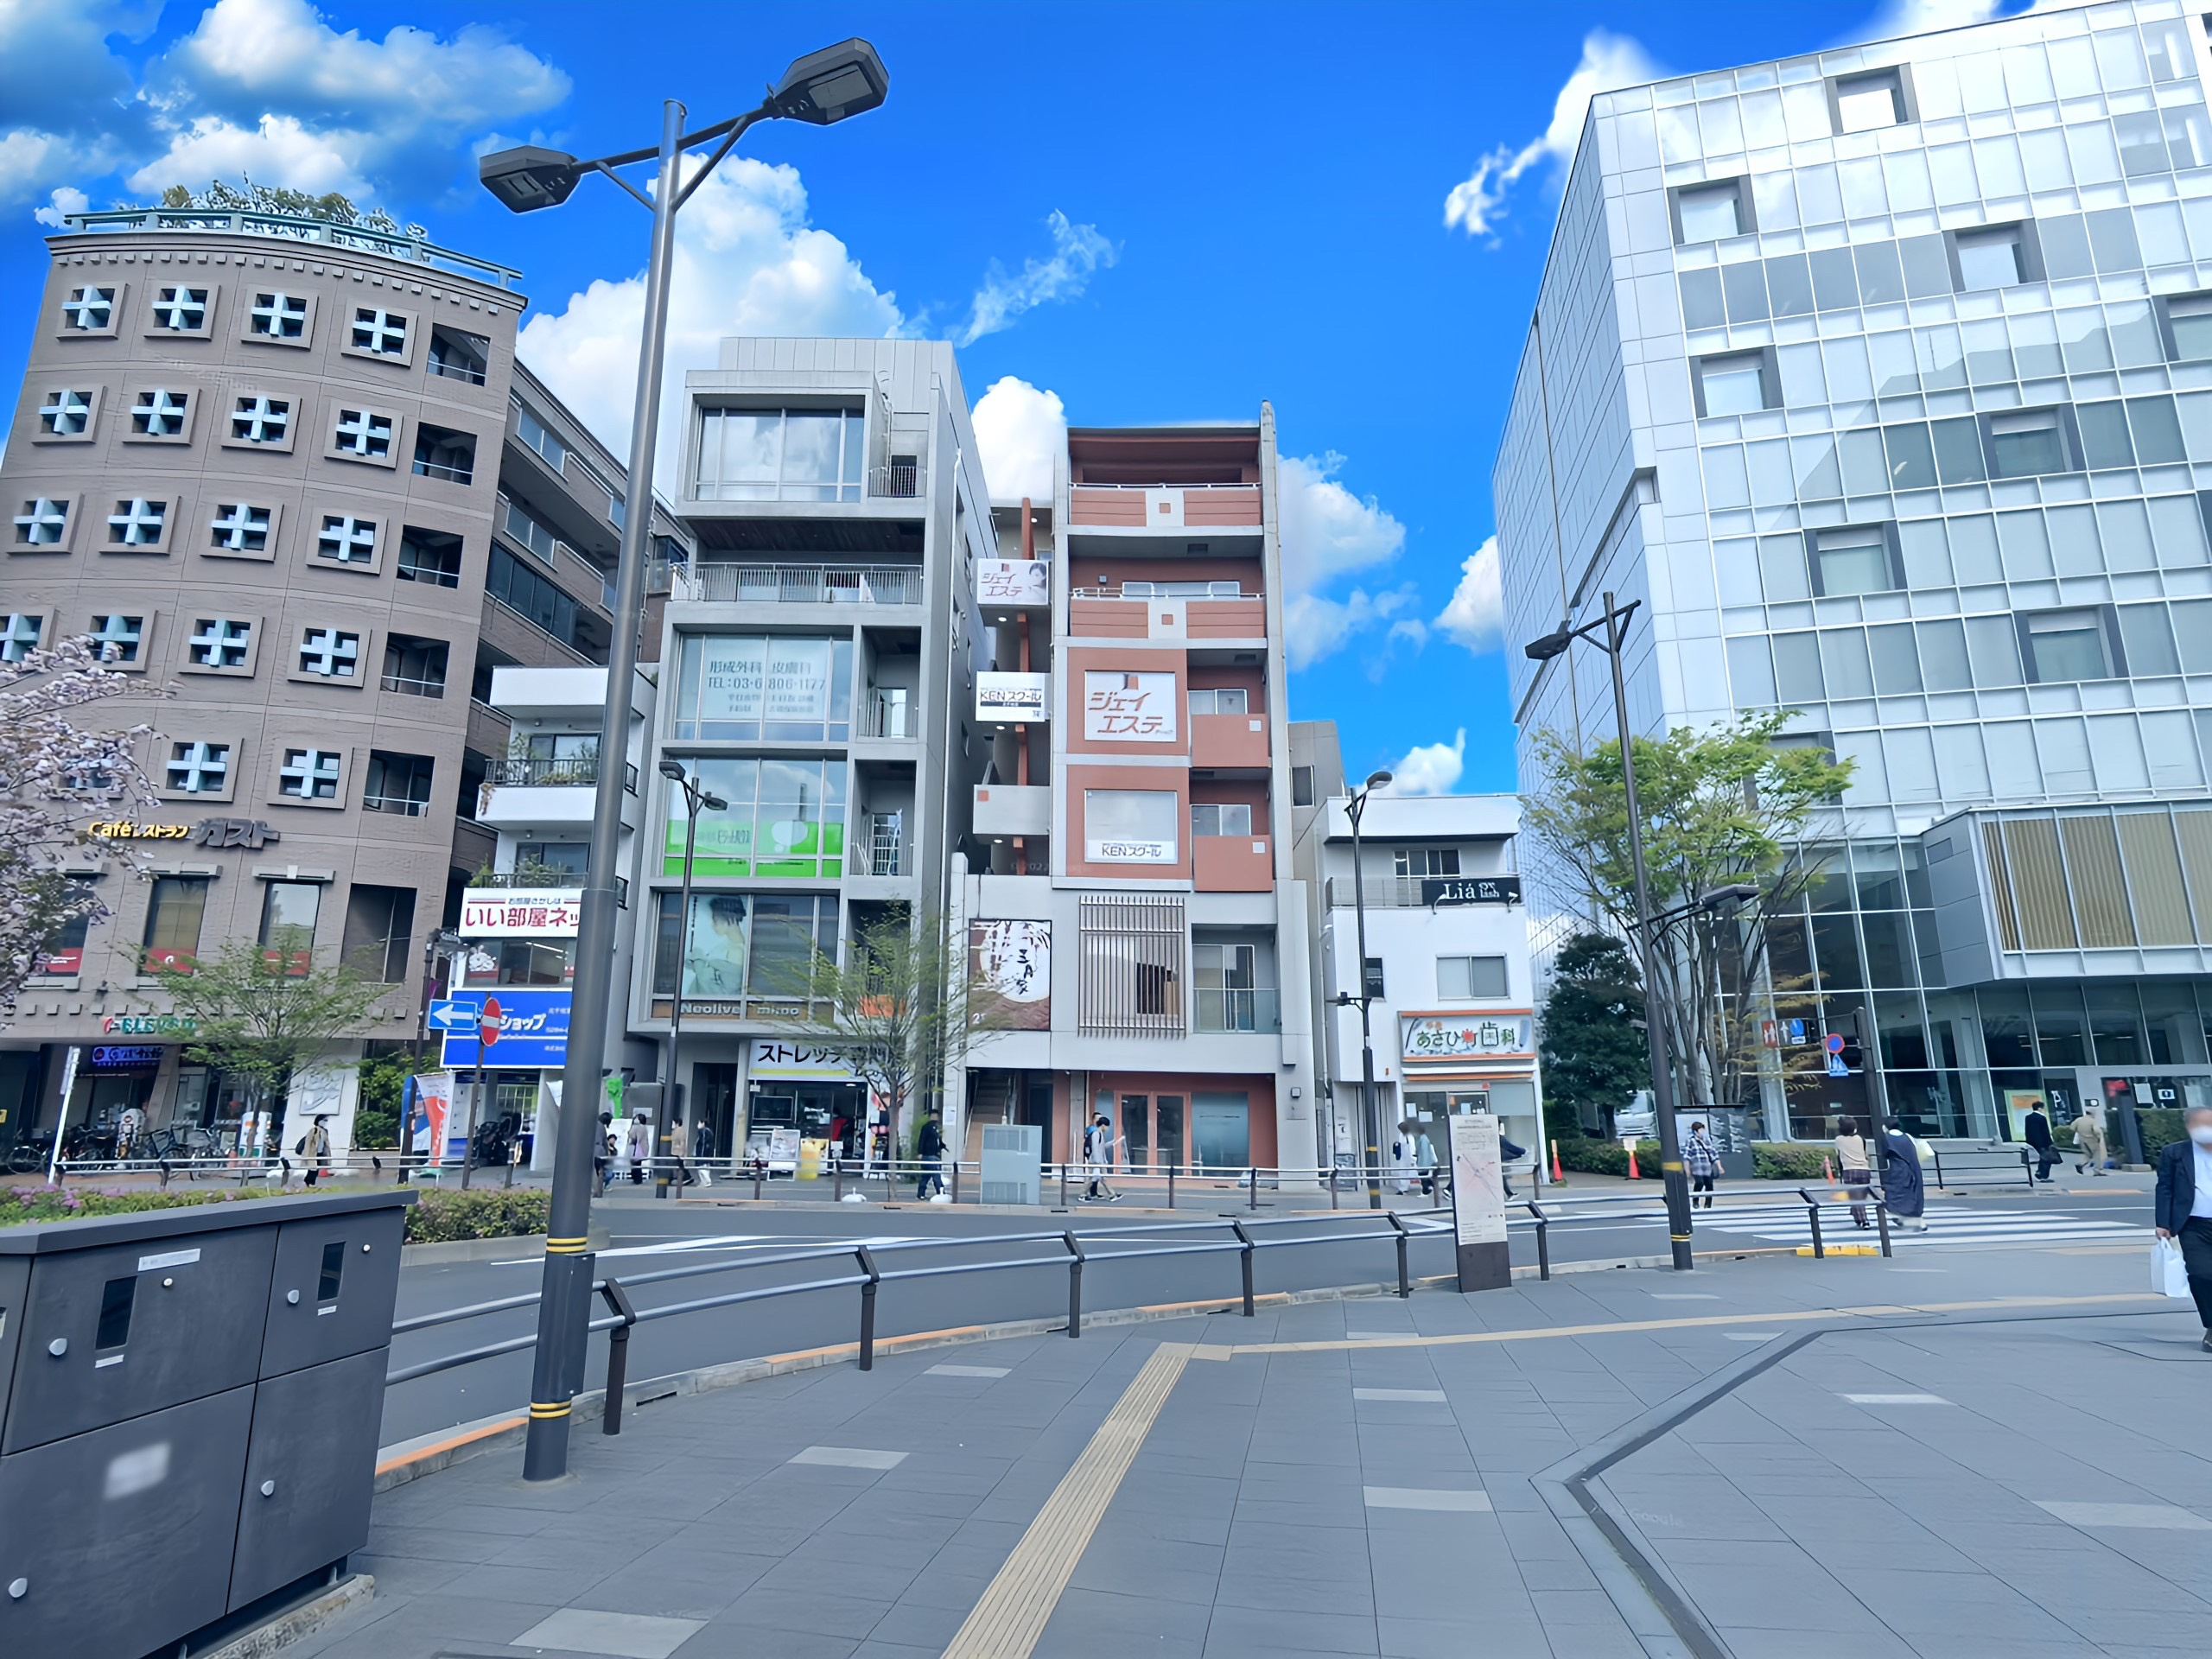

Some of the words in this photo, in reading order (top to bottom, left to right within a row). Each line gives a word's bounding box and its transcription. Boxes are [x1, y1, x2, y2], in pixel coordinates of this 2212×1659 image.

[985, 586, 1022, 596] エステ
[1088, 691, 1151, 711] ジェイ
